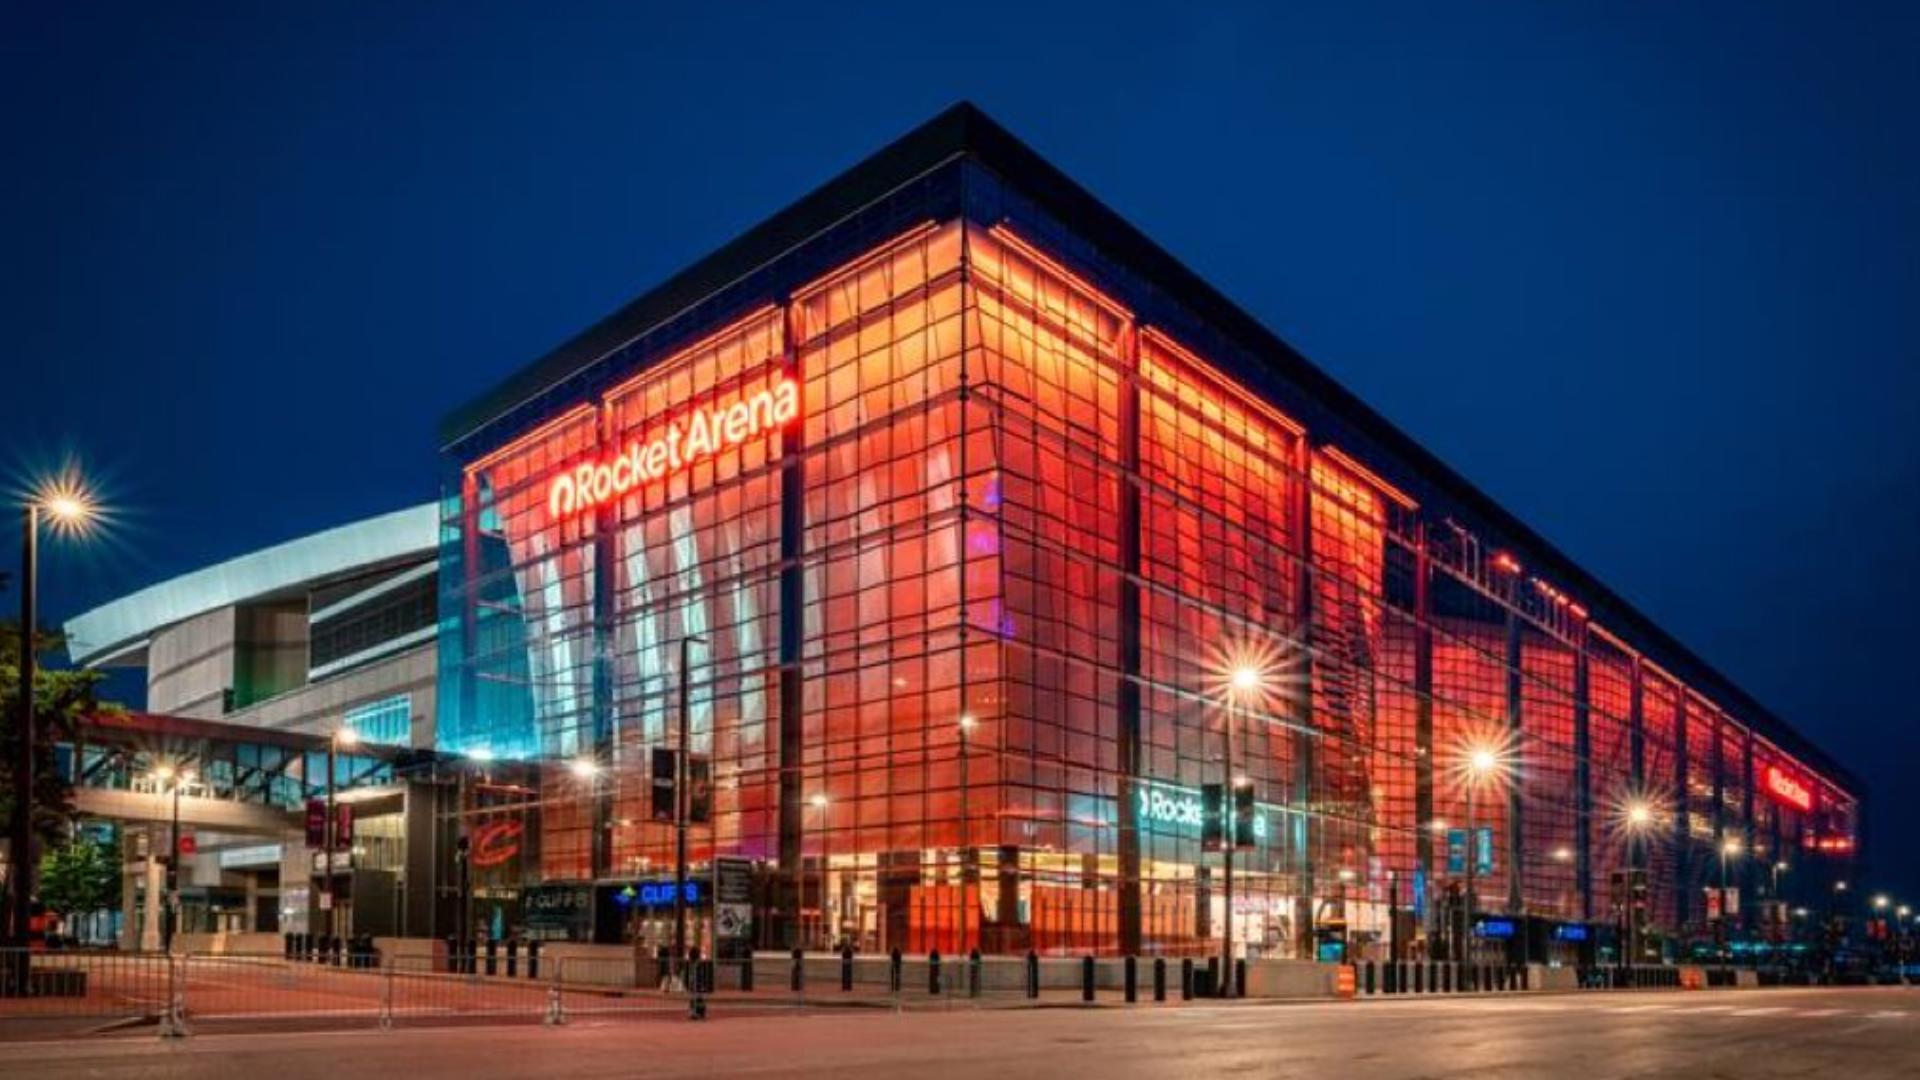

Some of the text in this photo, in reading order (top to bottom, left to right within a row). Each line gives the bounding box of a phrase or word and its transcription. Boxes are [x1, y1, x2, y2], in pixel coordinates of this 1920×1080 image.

[575, 379, 798, 511] Rocket Arena
[1150, 789, 1203, 827] Rocke
